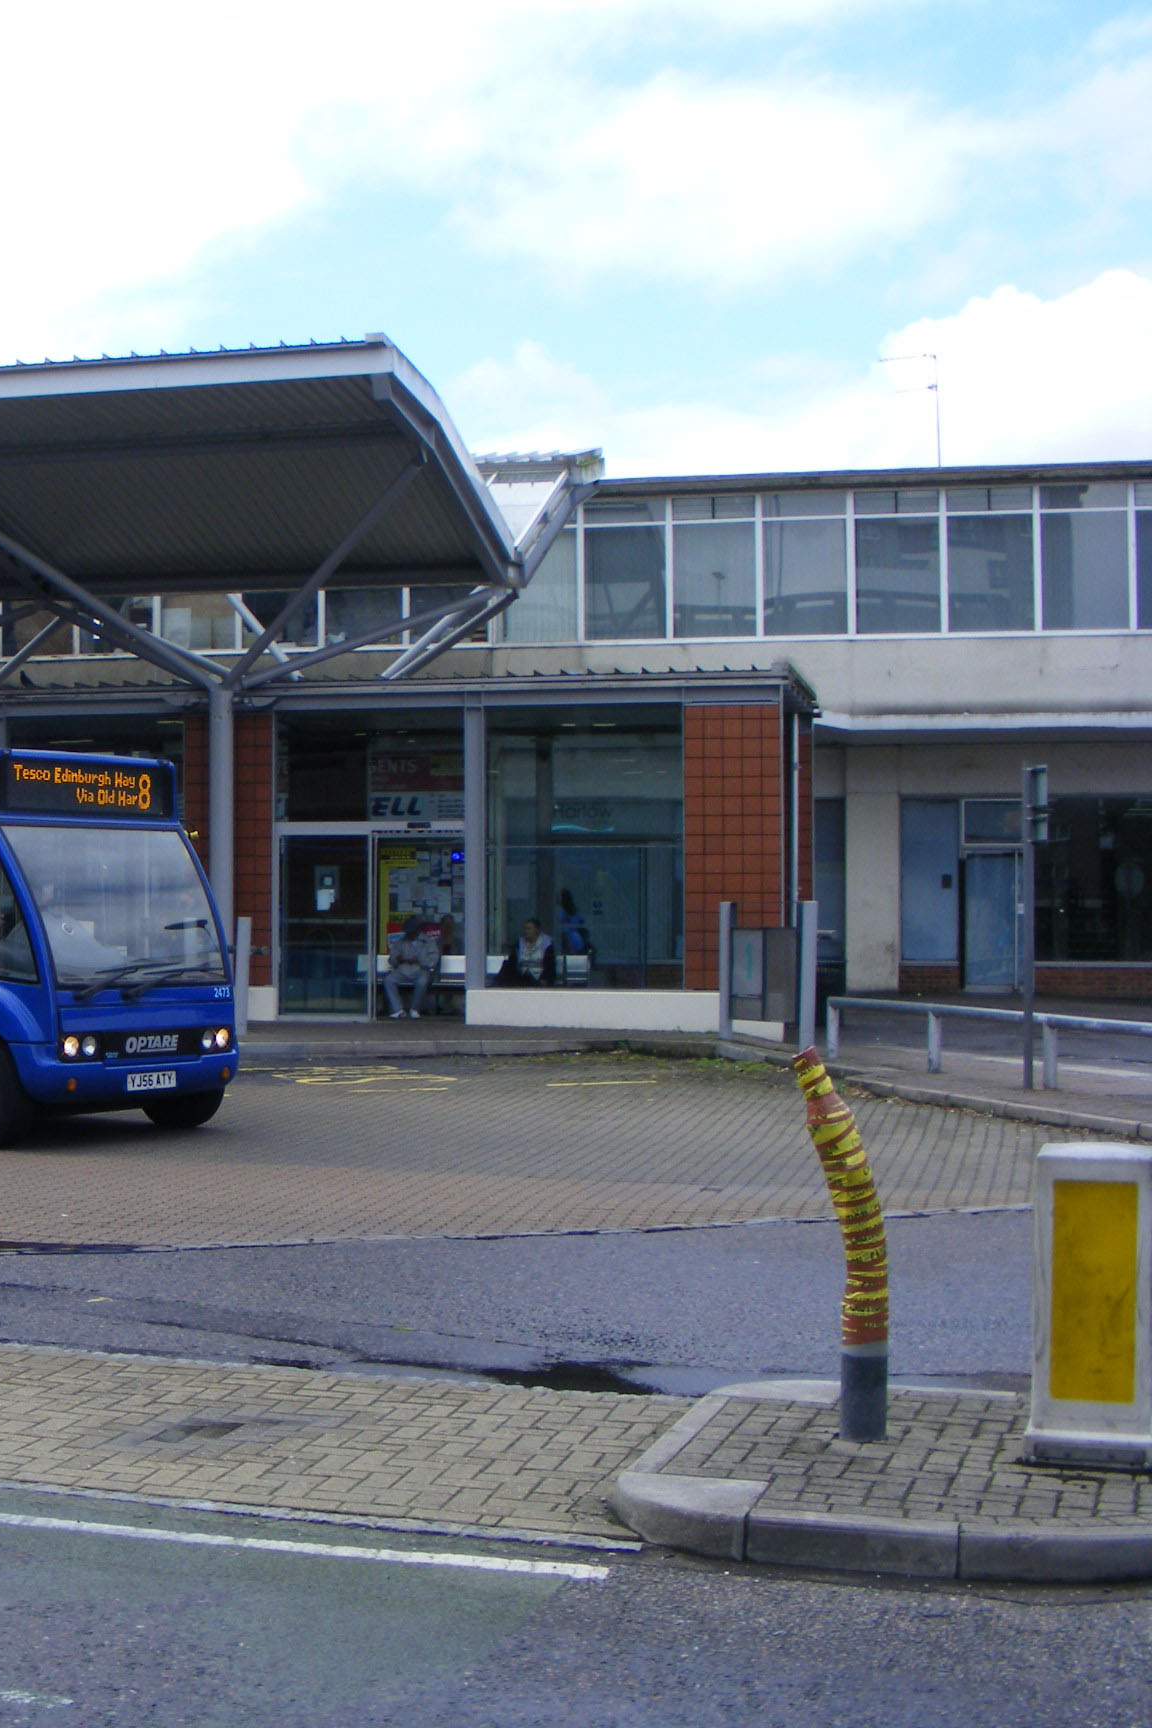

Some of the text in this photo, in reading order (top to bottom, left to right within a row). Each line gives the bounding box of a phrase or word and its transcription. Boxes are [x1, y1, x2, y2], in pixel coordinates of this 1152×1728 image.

[13, 764, 51, 781] Tesco
[54, 767, 112, 787] Edinburgh
[76, 787, 138, 807] Via Old Har
[138, 773, 151, 810] 8
[214, 987, 231, 998] 2473
[126, 1035, 179, 1053] OPTARE
[130, 1073, 173, 1087] YJ56 ATY
